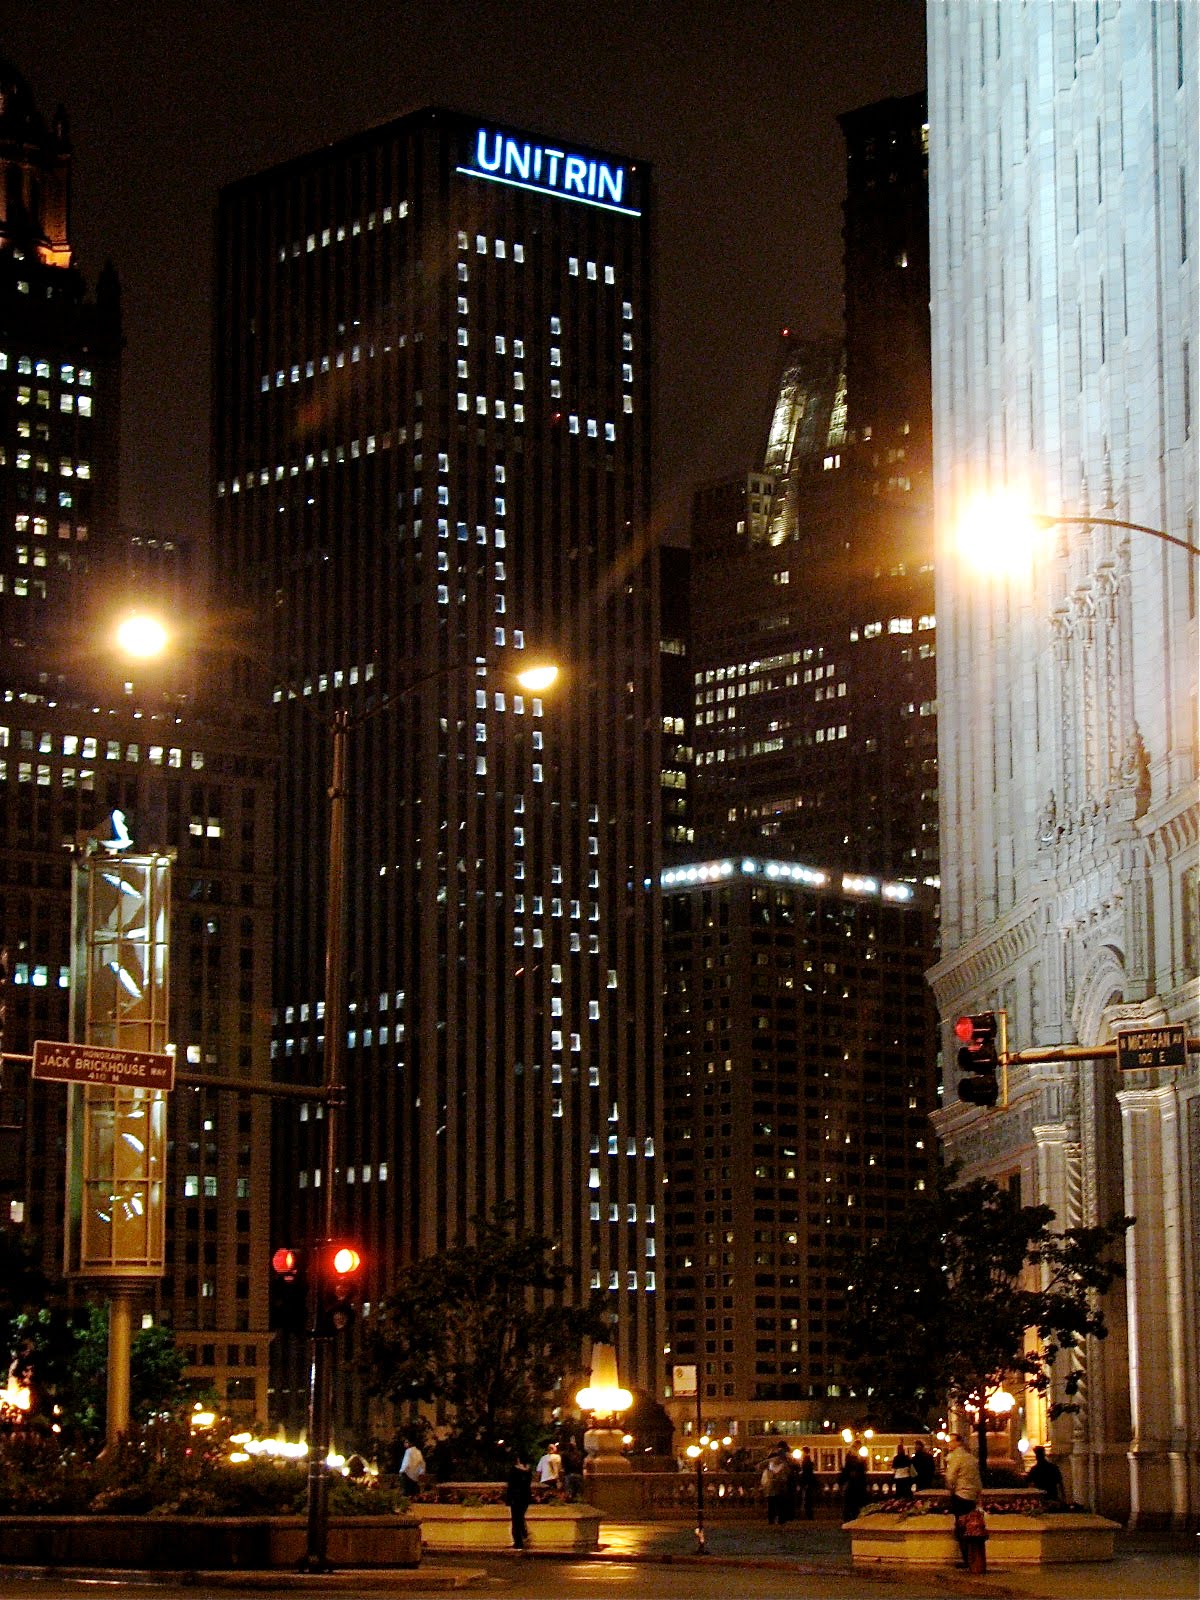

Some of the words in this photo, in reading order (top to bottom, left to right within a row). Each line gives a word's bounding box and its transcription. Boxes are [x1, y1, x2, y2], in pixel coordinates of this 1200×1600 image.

[477, 129, 624, 203] UNITRIN
[1127, 1031, 1171, 1051] MICHIGAN
[40, 1054, 70, 1069] JACK
[74, 1058, 147, 1077] BRICKHOUSE
[150, 1067, 167, 1077] WAY
[82, 1050, 126, 1061] HONORARY
[1159, 1051, 1166, 1063] E
